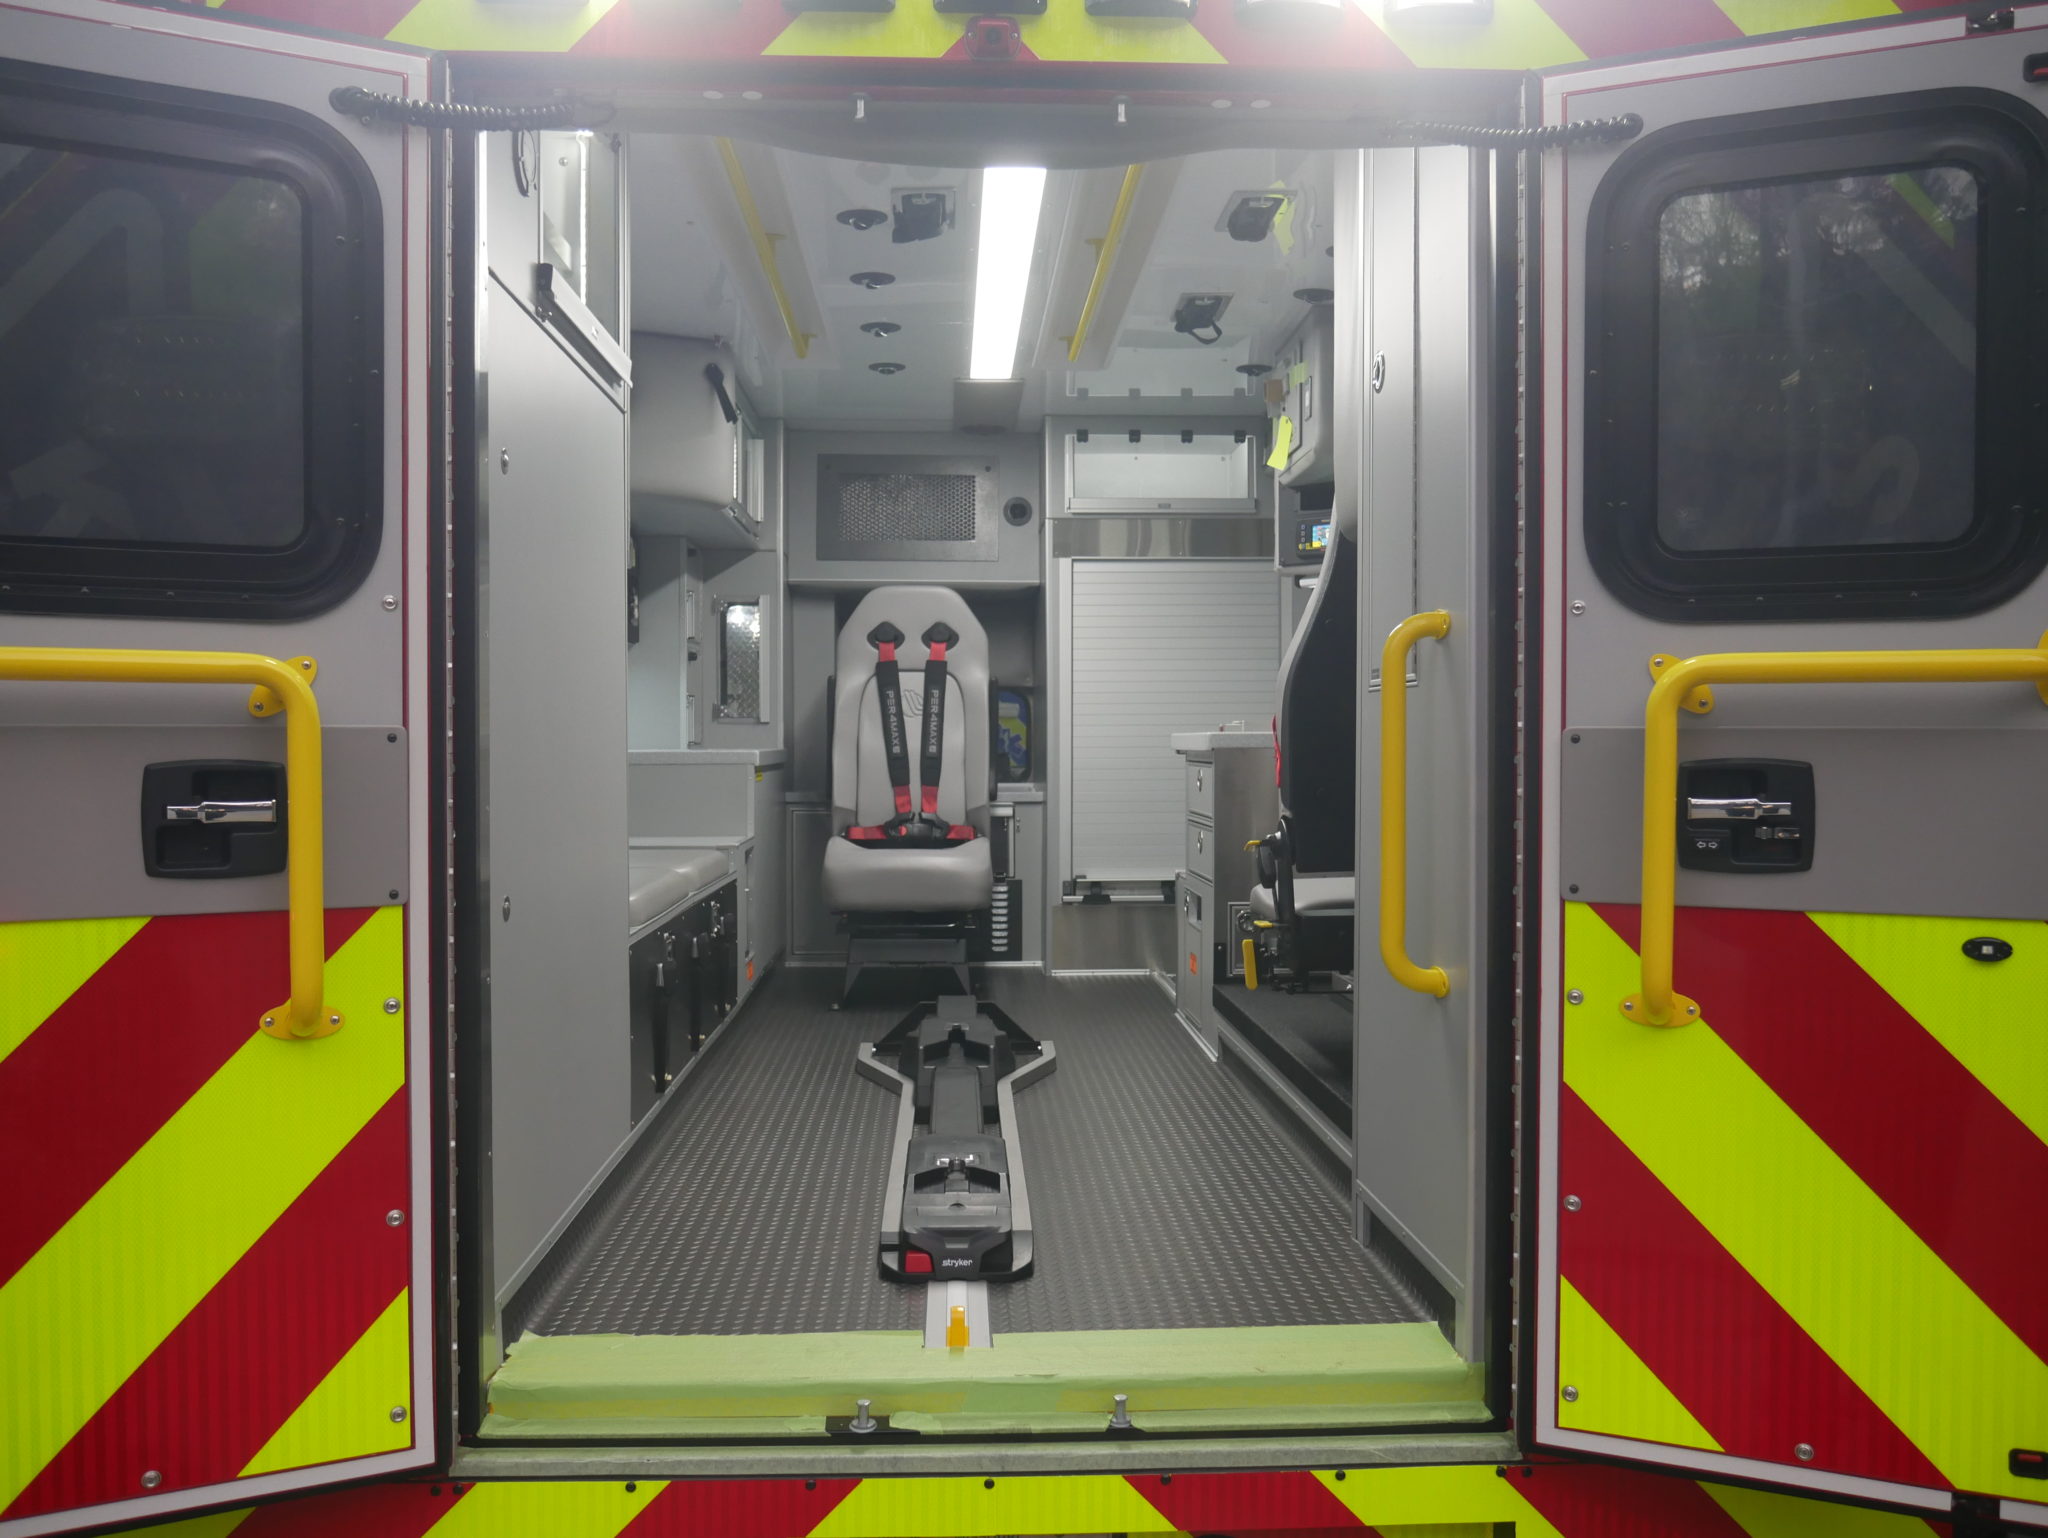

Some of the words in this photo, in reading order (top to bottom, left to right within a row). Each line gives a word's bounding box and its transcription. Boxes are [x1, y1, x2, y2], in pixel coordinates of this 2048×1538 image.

[885, 690, 901, 745] PER4MAX
[928, 689, 940, 745] PER4MAX
[942, 1258, 973, 1268] stryker
